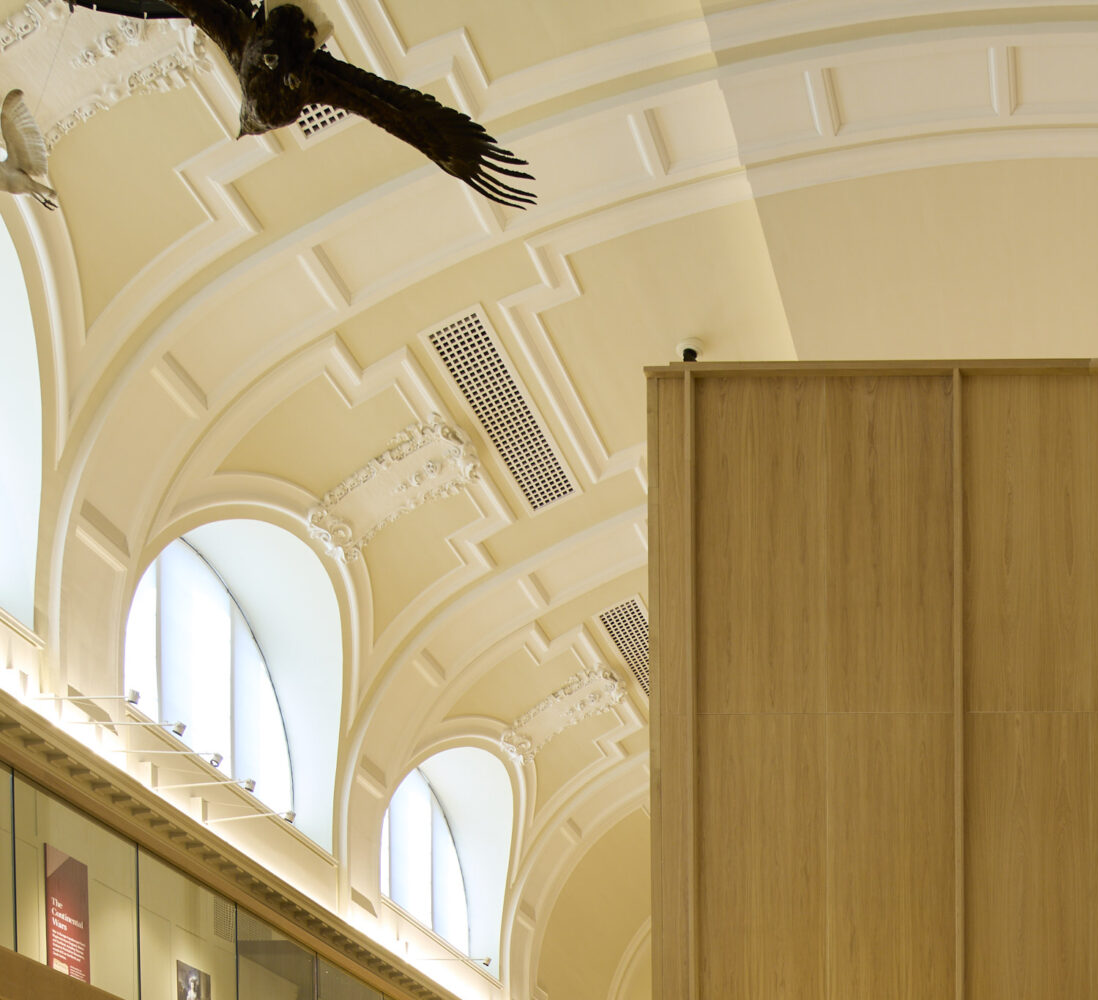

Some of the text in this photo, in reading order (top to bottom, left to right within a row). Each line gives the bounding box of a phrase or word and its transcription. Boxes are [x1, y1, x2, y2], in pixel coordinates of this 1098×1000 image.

[51, 896, 63, 909] The
[51, 907, 84, 929] Continental
[52, 917, 68, 932] Wars
